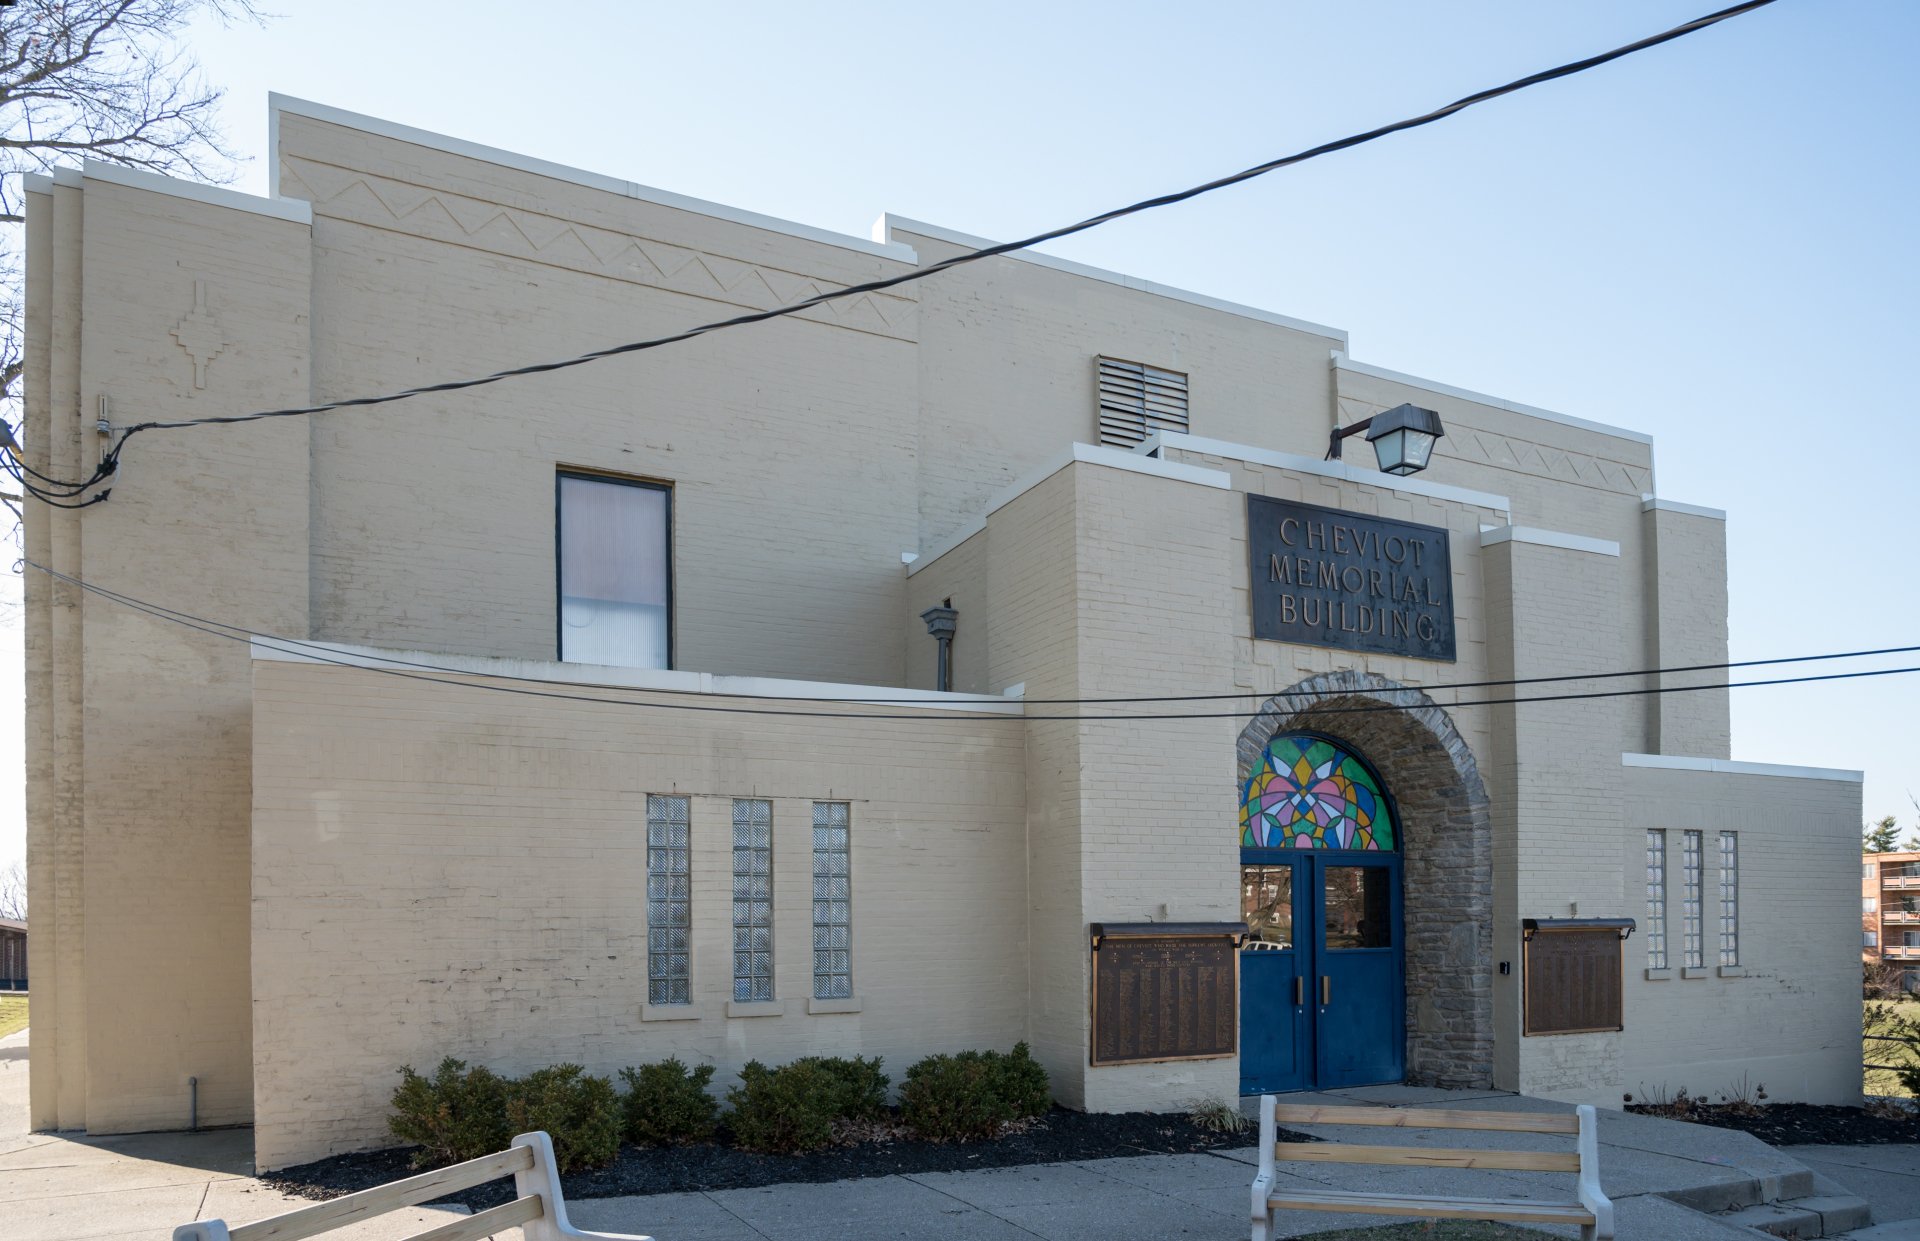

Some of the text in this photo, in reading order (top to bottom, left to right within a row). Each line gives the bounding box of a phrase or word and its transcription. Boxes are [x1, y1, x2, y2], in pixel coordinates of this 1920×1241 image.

[1280, 518, 1425, 567] CHEVIOT
[1270, 553, 1441, 606] MEMORIAL
[1281, 594, 1433, 641] BUILDING
